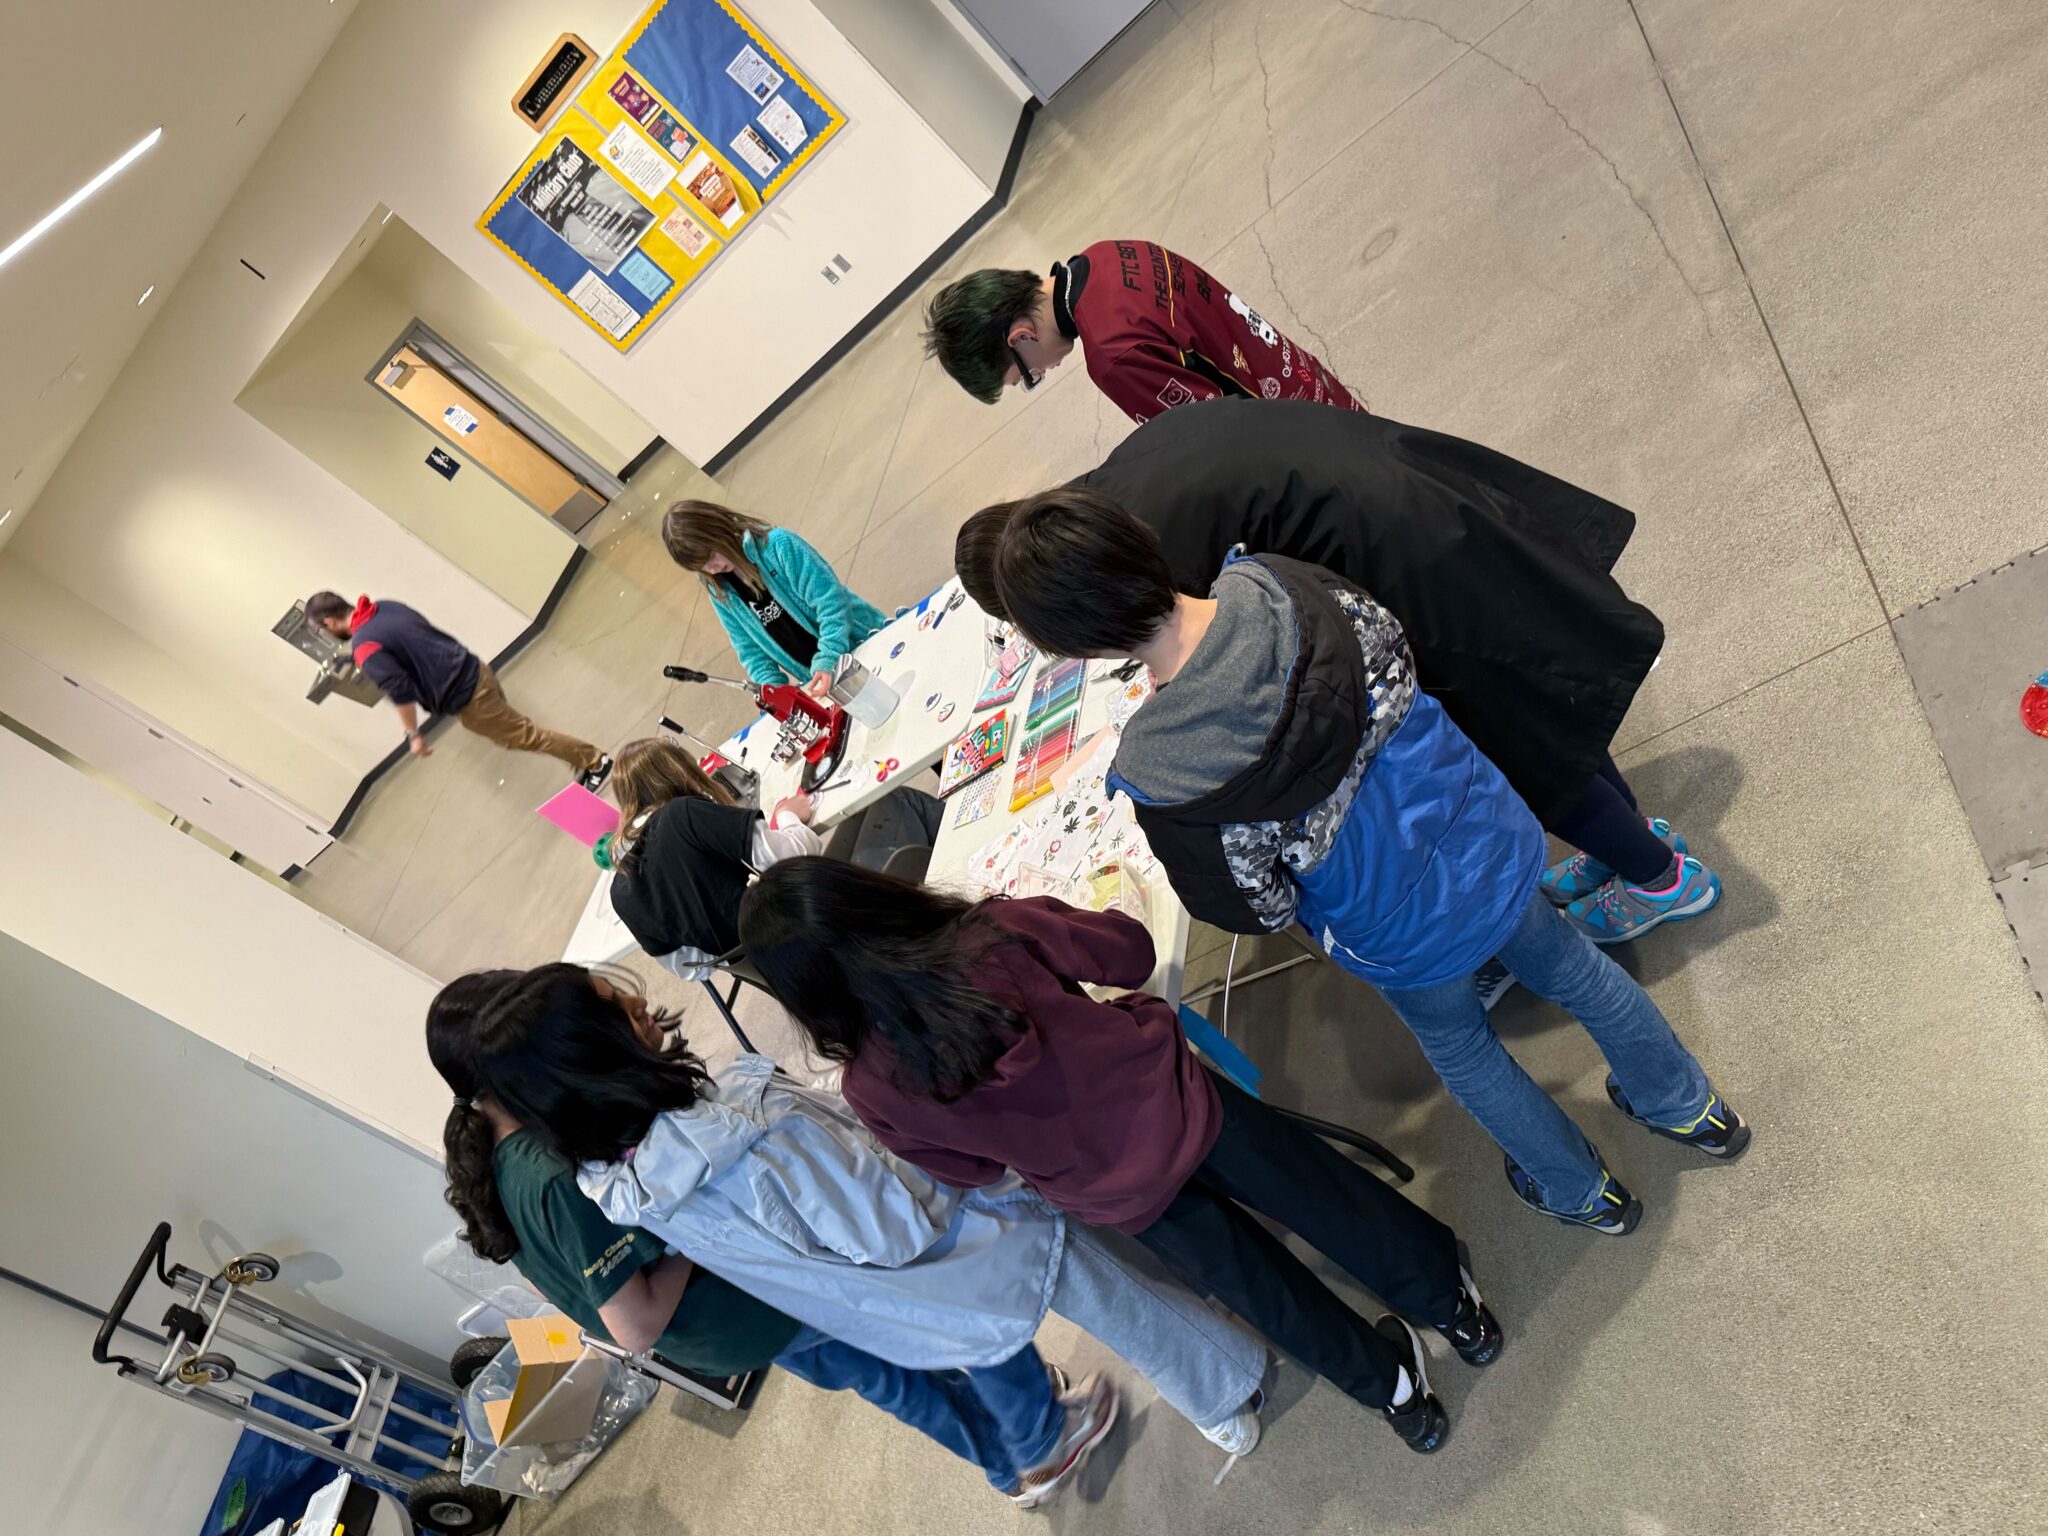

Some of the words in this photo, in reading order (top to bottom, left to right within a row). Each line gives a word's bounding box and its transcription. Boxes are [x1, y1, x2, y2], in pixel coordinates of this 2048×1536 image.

[525, 48, 582, 115] Community
[532, 173, 567, 212] Military
[559, 153, 584, 179] Club
[1121, 260, 1142, 292] FTC
[1154, 283, 1170, 309] THE
